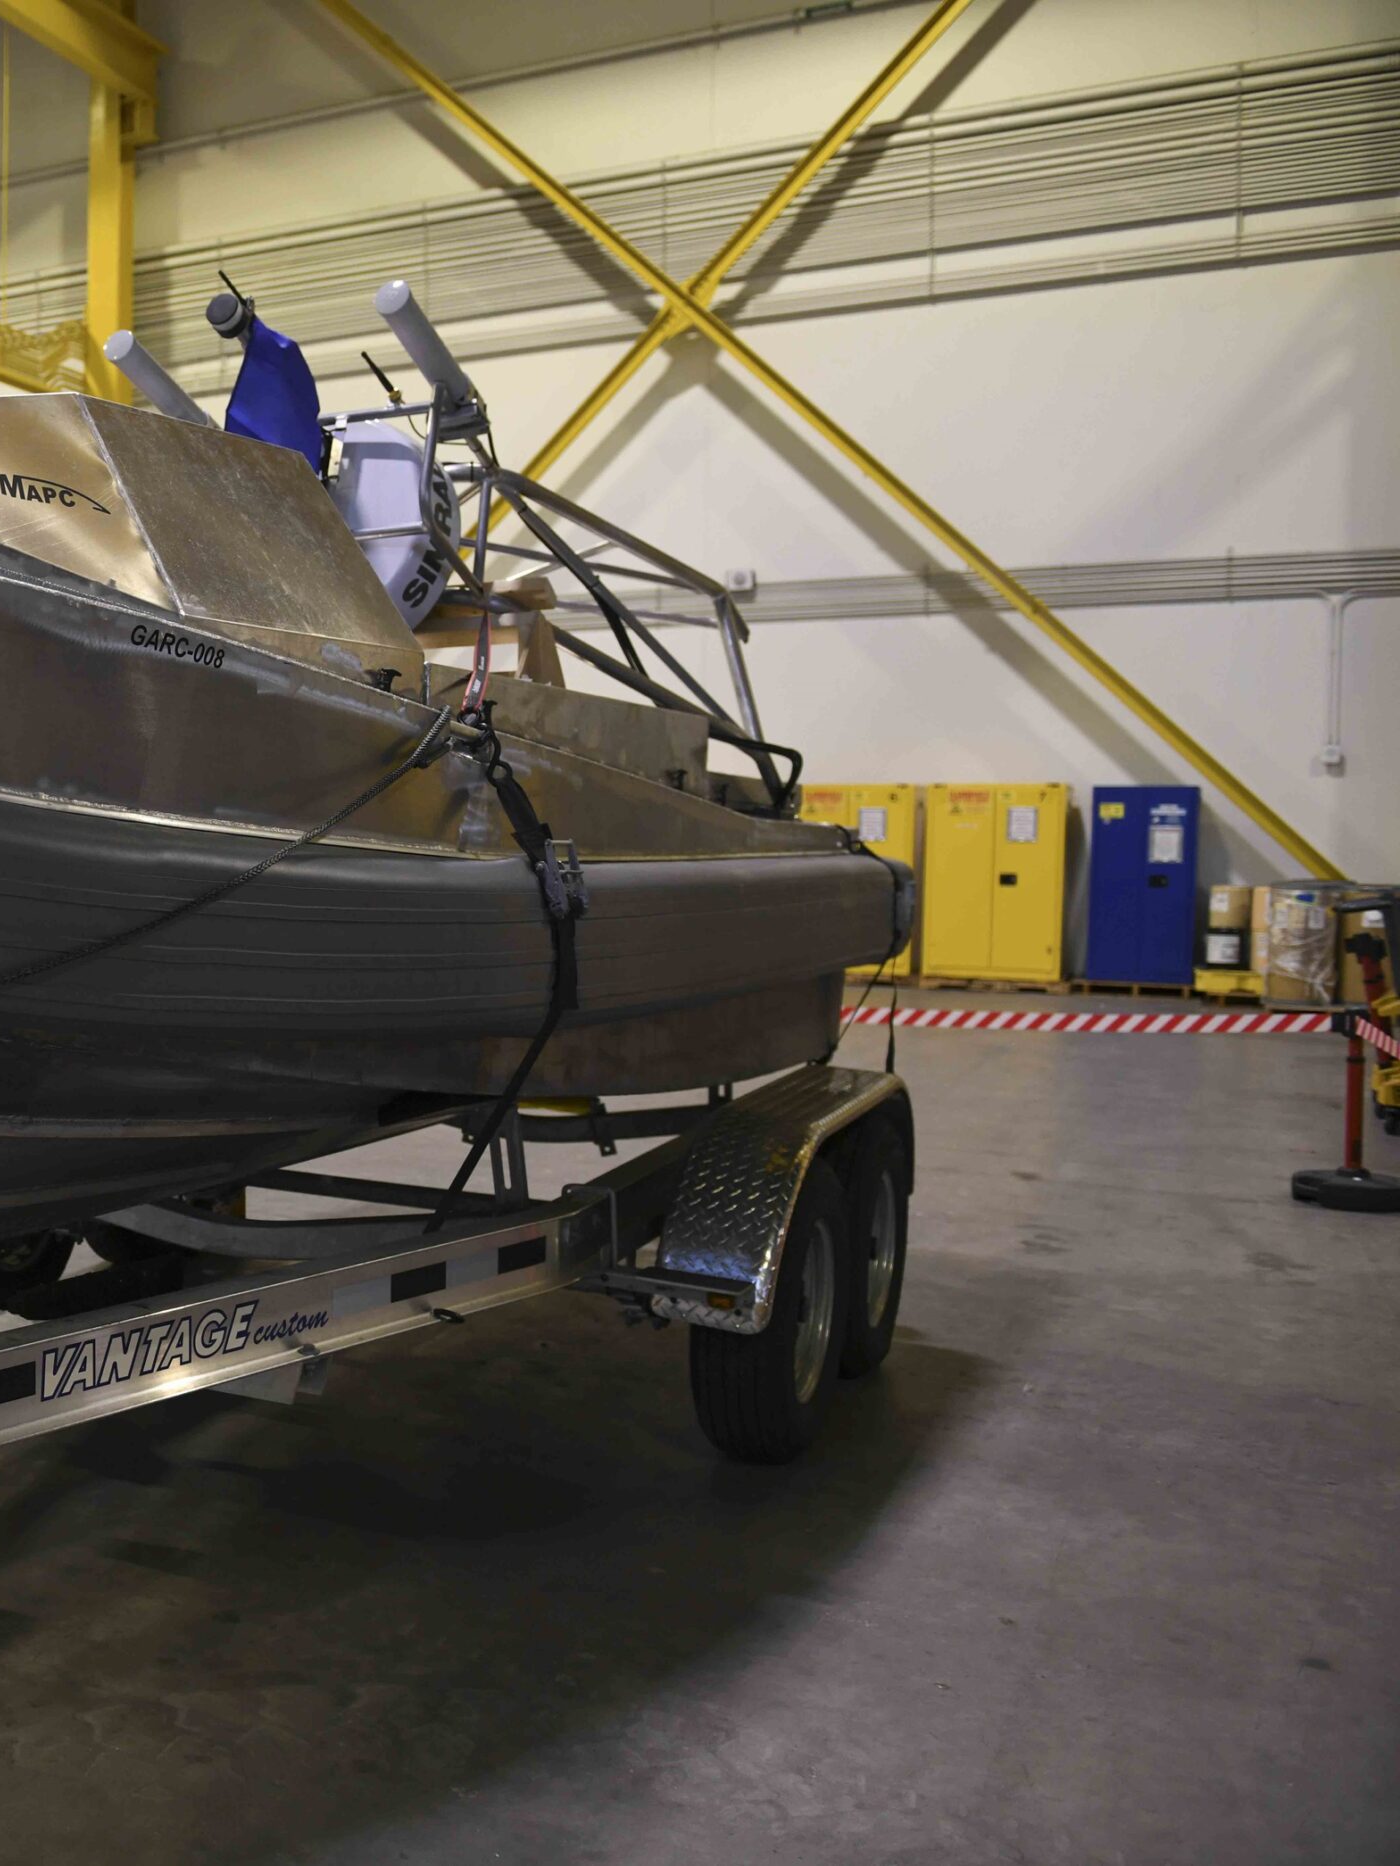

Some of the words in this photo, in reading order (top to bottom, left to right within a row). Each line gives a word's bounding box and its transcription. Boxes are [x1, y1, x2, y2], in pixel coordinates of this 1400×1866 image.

[0, 474, 77, 508] MAPC
[130, 624, 225, 669] GARC-008
[40, 1299, 260, 1402] VANTAGE
[253, 1306, 329, 1346] custom
